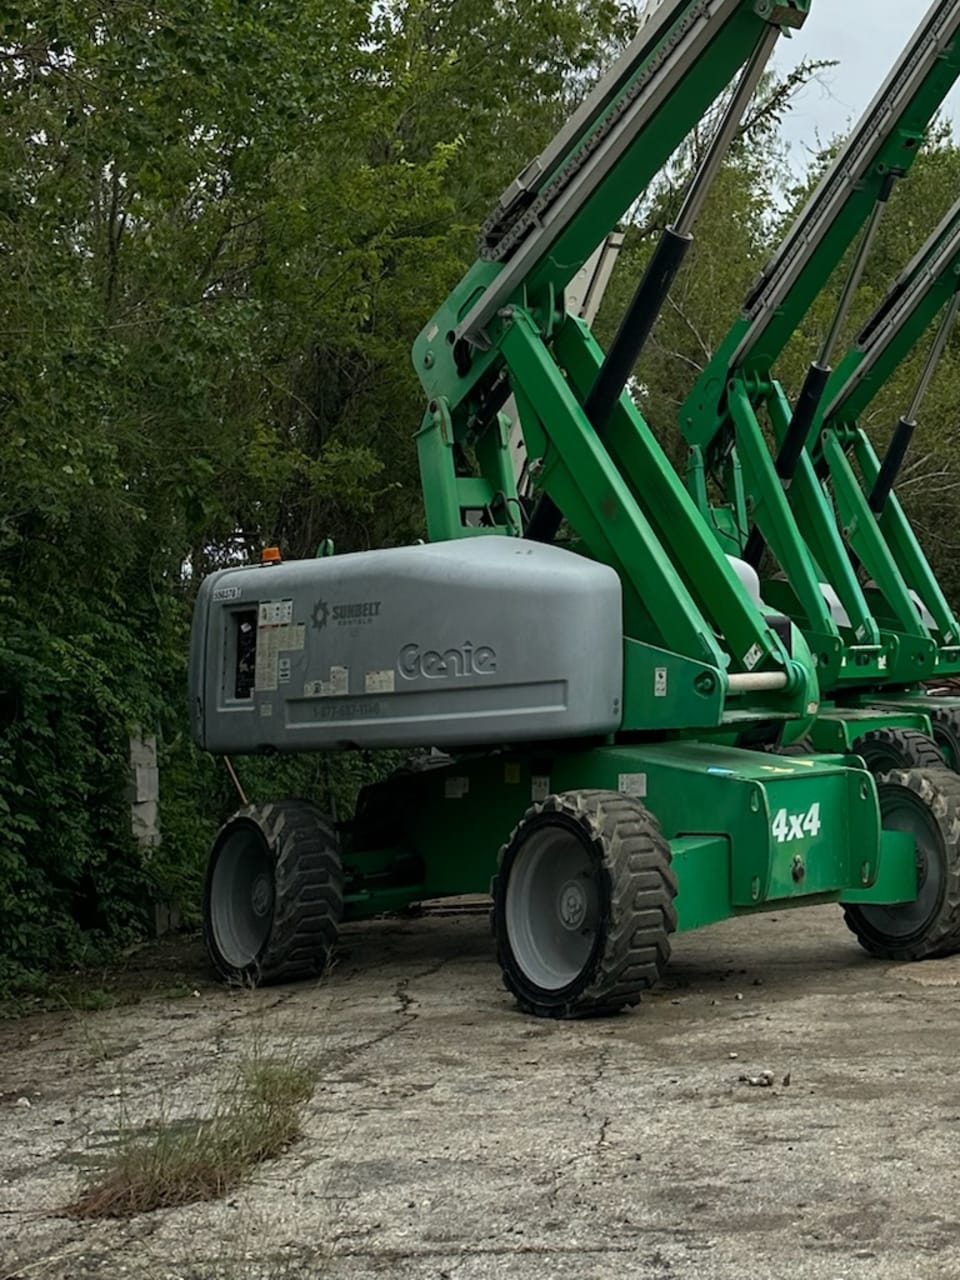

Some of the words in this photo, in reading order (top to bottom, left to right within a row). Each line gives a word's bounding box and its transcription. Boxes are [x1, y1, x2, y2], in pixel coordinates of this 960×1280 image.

[332, 601, 382, 620] SUNBELT
[398, 640, 497, 680] Genie
[772, 802, 821, 842] 4x4
